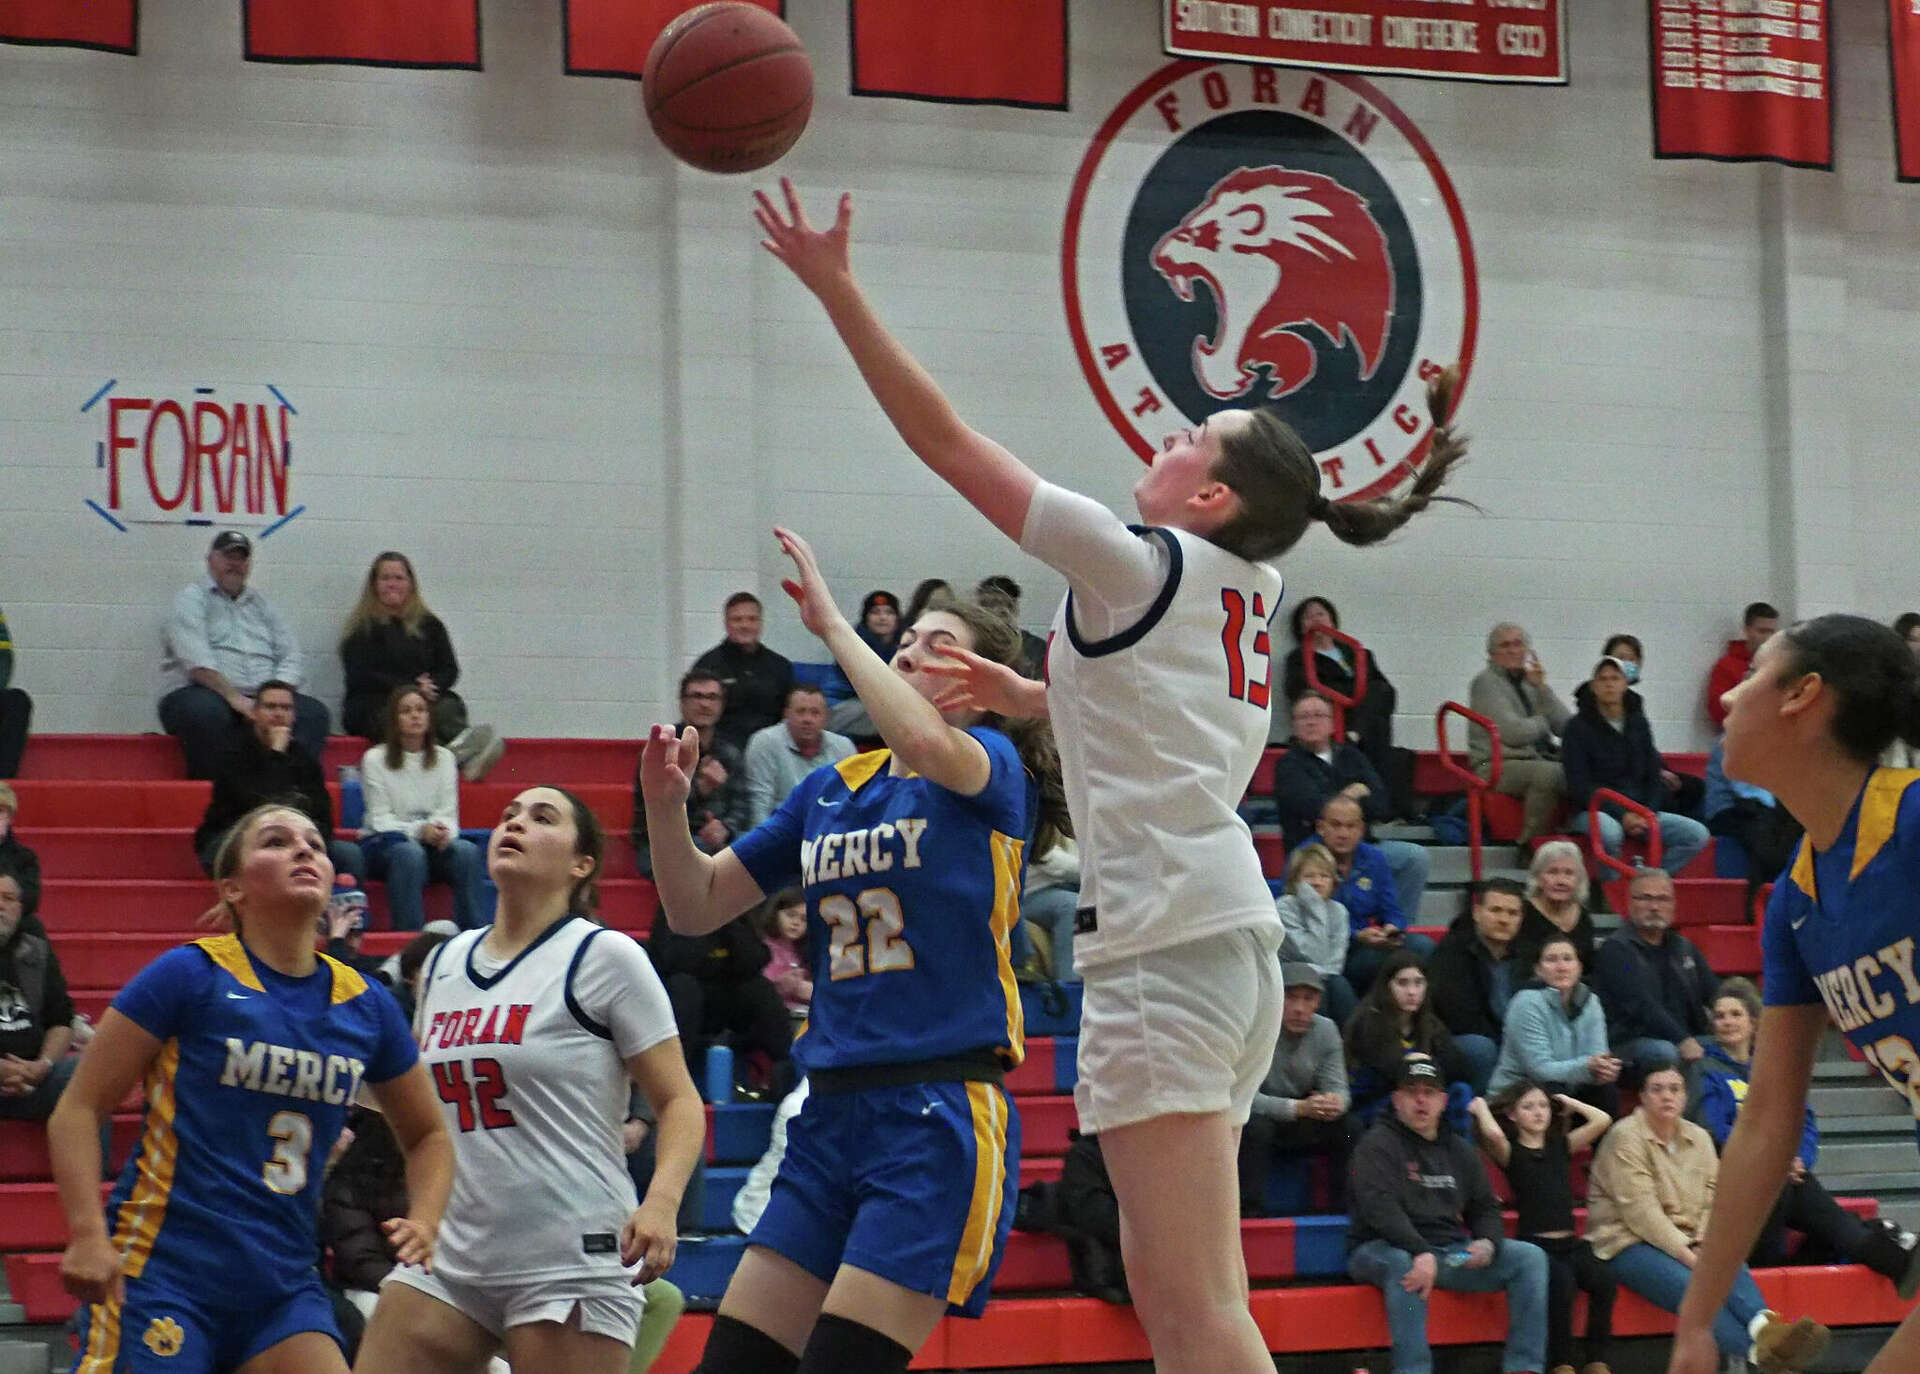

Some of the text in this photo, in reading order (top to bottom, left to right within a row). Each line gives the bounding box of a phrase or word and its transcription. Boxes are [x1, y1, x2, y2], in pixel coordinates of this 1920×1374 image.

[1153, 65, 1381, 145] FORAN
[107, 397, 289, 517] FORAN
[800, 818, 928, 889] MERCY
[818, 886, 915, 981] 22
[421, 1003, 533, 1052] FORAN
[430, 1057, 518, 1133] 42
[262, 1110, 313, 1196] 3
